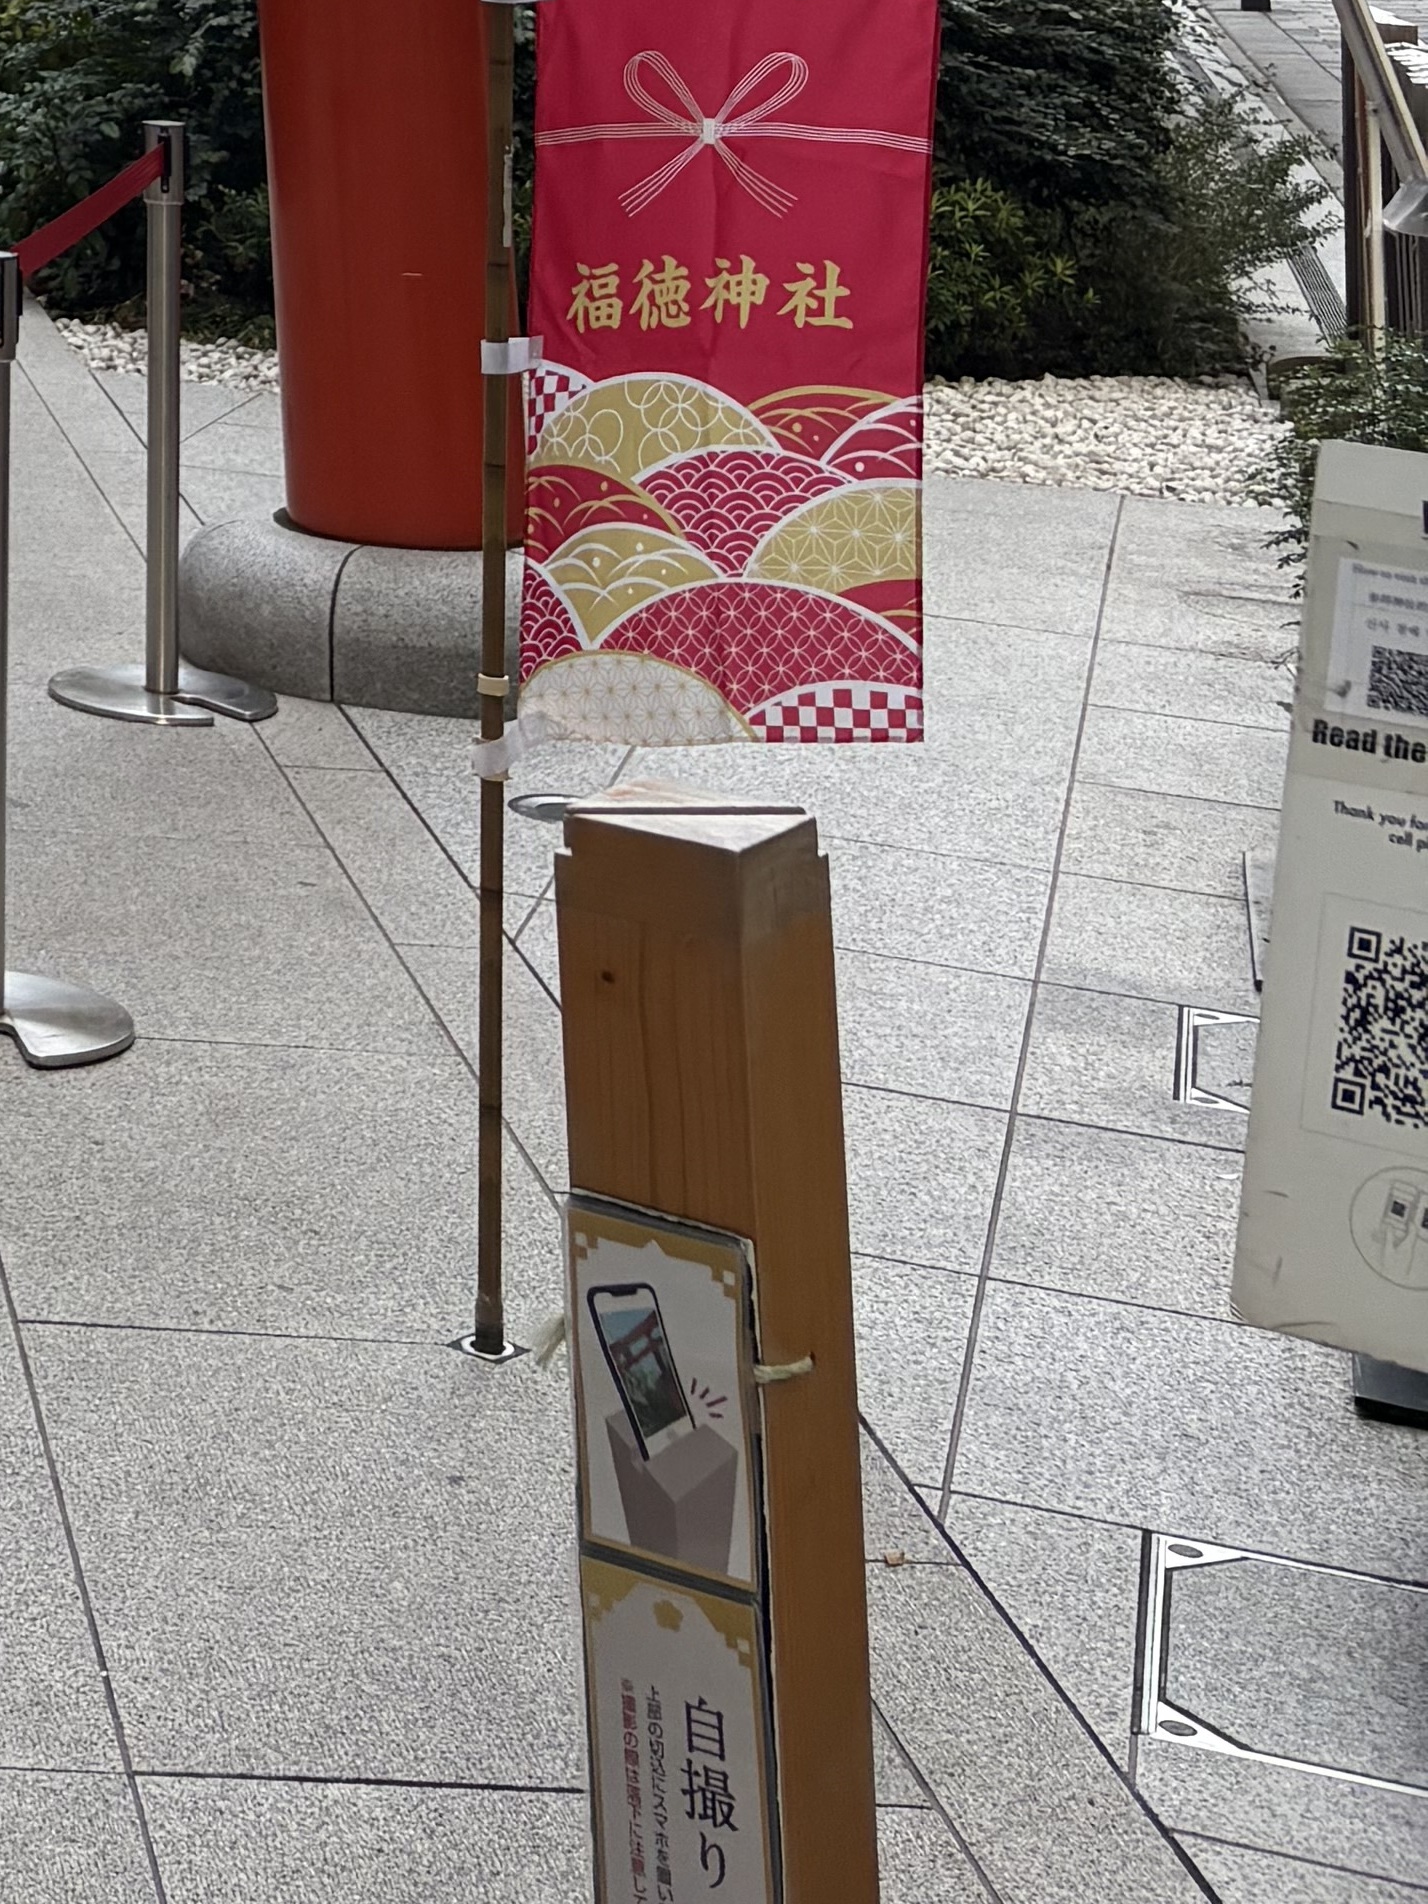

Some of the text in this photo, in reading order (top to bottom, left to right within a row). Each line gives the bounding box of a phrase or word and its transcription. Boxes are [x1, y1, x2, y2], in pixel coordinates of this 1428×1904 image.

[565, 253, 855, 334] 福徳神社
[1311, 718, 1427, 763] Read the
[1334, 799, 1374, 821] Thank
[1378, 813, 1406, 827] you
[1388, 830, 1413, 848] cell
[679, 1695, 740, 1890] 自撮り
